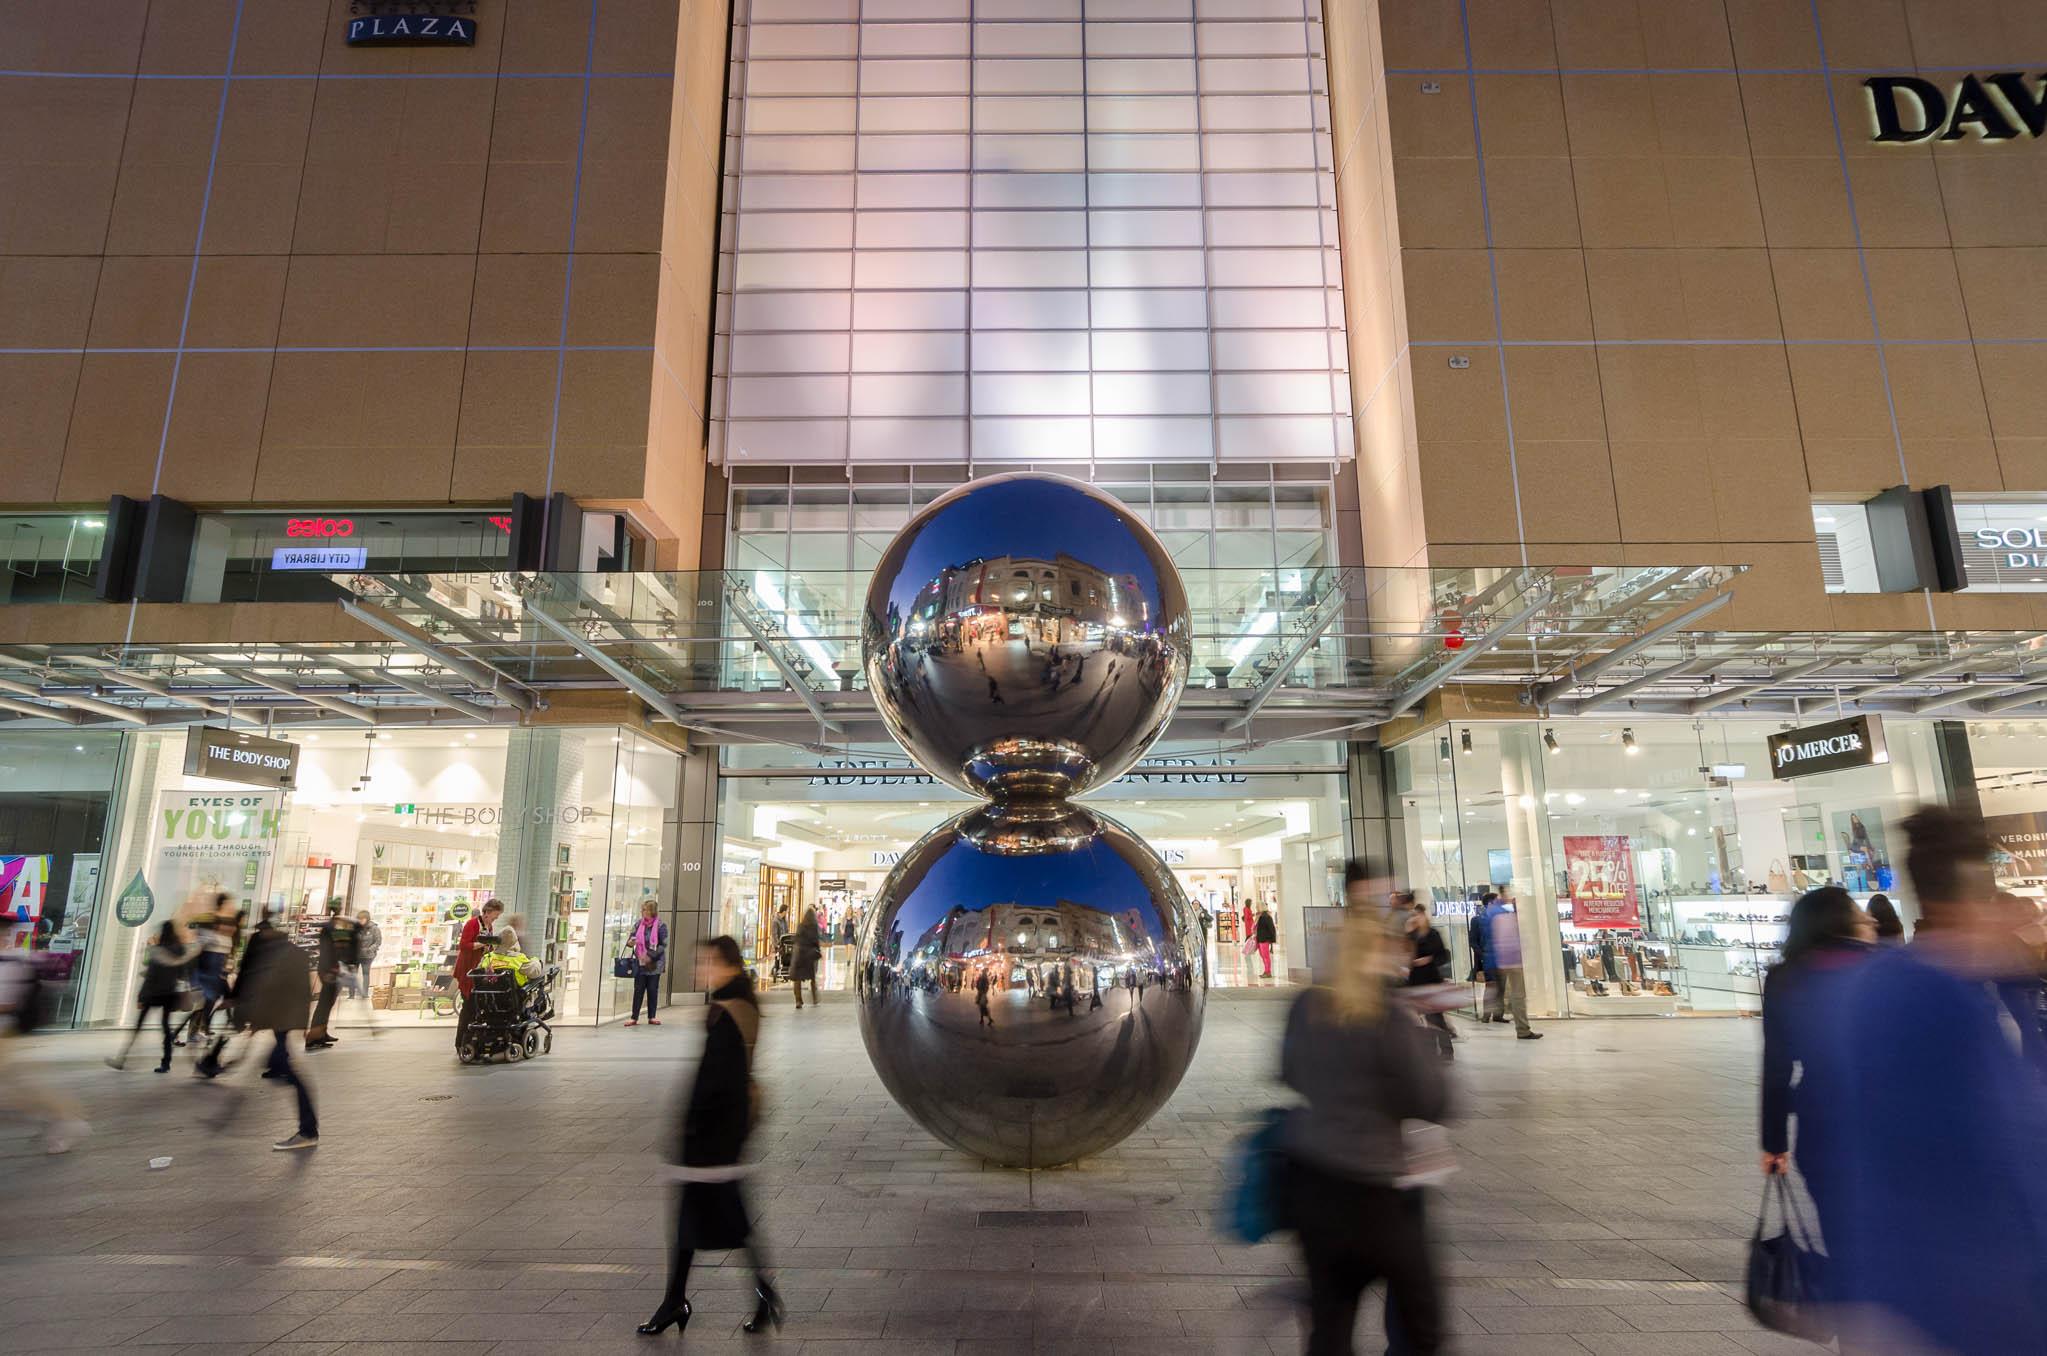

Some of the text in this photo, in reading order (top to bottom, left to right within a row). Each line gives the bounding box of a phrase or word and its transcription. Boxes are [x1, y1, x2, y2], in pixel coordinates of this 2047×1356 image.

[351, 17, 467, 38] PLAZA
[208, 745, 291, 770] THE BODY SHOP
[1777, 733, 1863, 767] JO MERCER
[189, 798, 263, 807] EYES OF
[164, 809, 279, 840] YOUTH
[414, 807, 455, 825] THE
[533, 806, 593, 825] SHOP
[682, 863, 701, 872] 100
[1571, 859, 1627, 897] 25%
[1610, 883, 1629, 896] OFF
